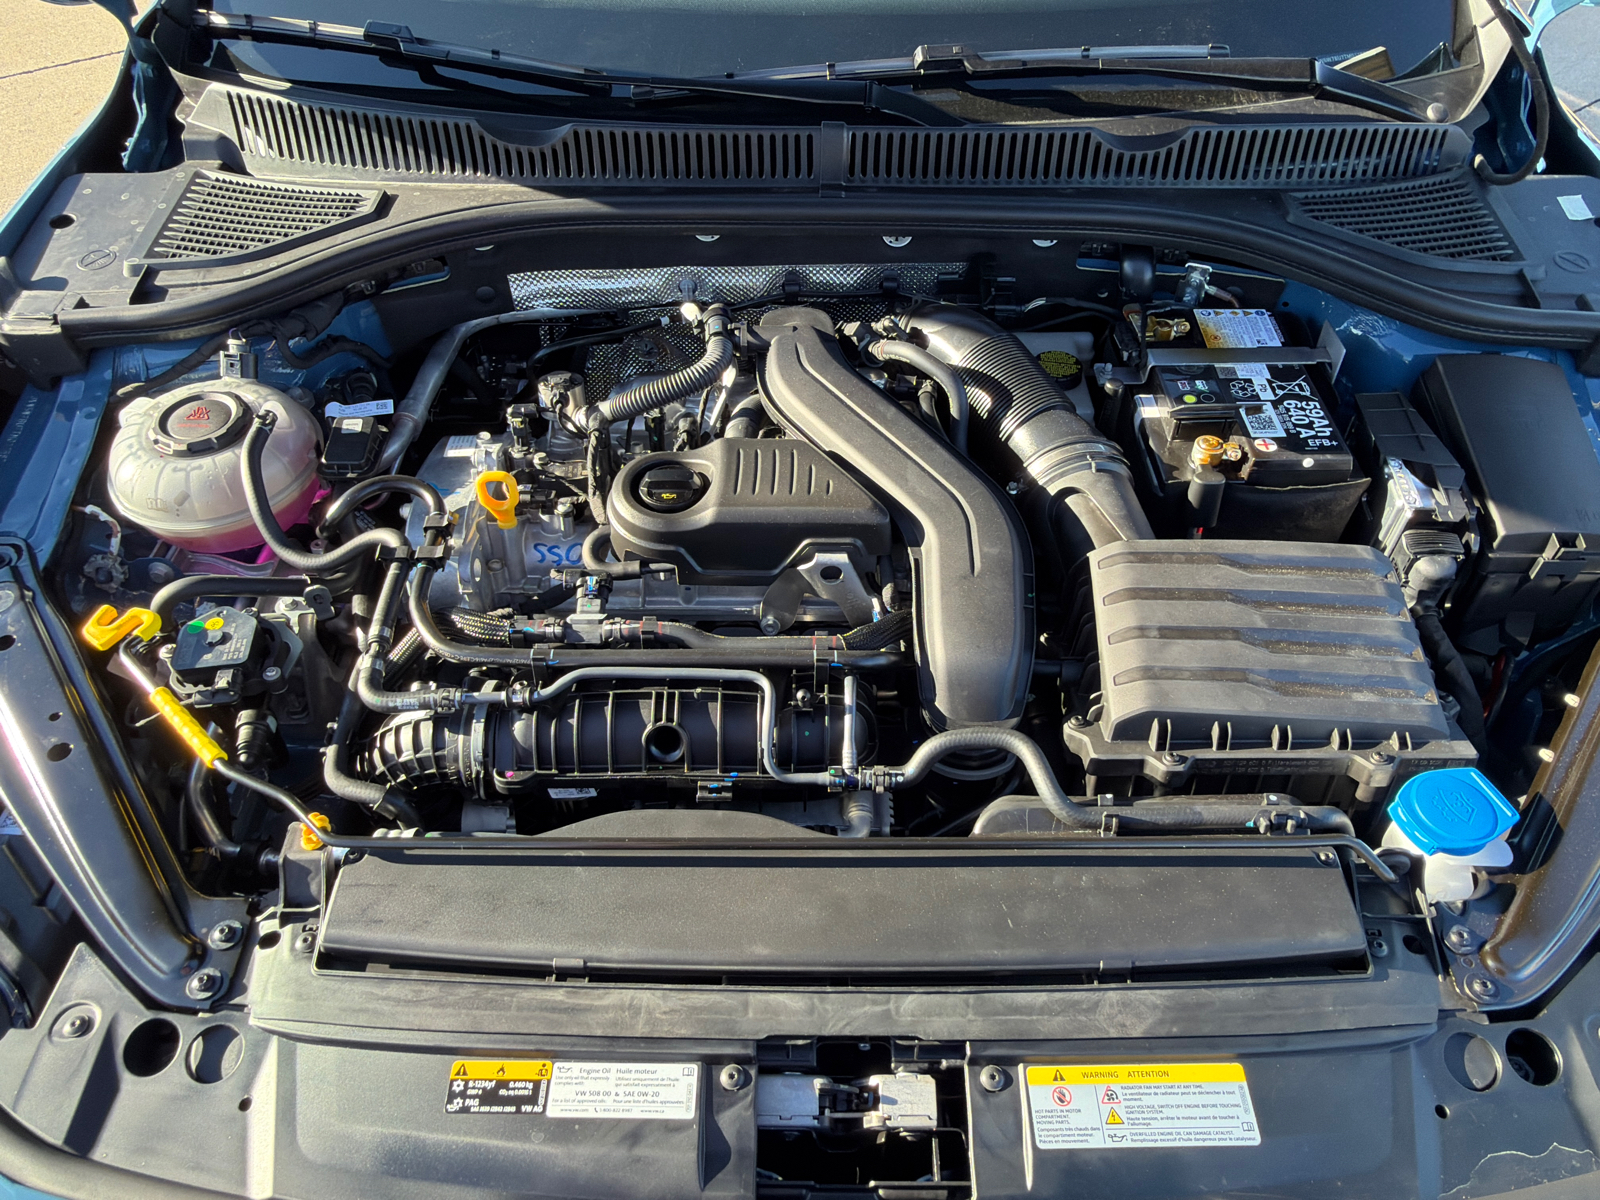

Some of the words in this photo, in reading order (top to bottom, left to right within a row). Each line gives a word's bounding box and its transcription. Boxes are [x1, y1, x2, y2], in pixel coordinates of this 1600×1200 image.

[1258, 383, 1269, 393] Pb
[1283, 400, 1308, 423] 640
[1296, 428, 1316, 438] A
[1301, 401, 1333, 436] 59Ah
[1307, 438, 1339, 447] EFB+
[1081, 1070, 1119, 1079] WARNING
[1127, 1069, 1170, 1078] ATTENTION
[468, 1080, 496, 1089] R-1234yf
[526, 1081, 533, 1089] kg
[464, 1098, 479, 1106] PAG
